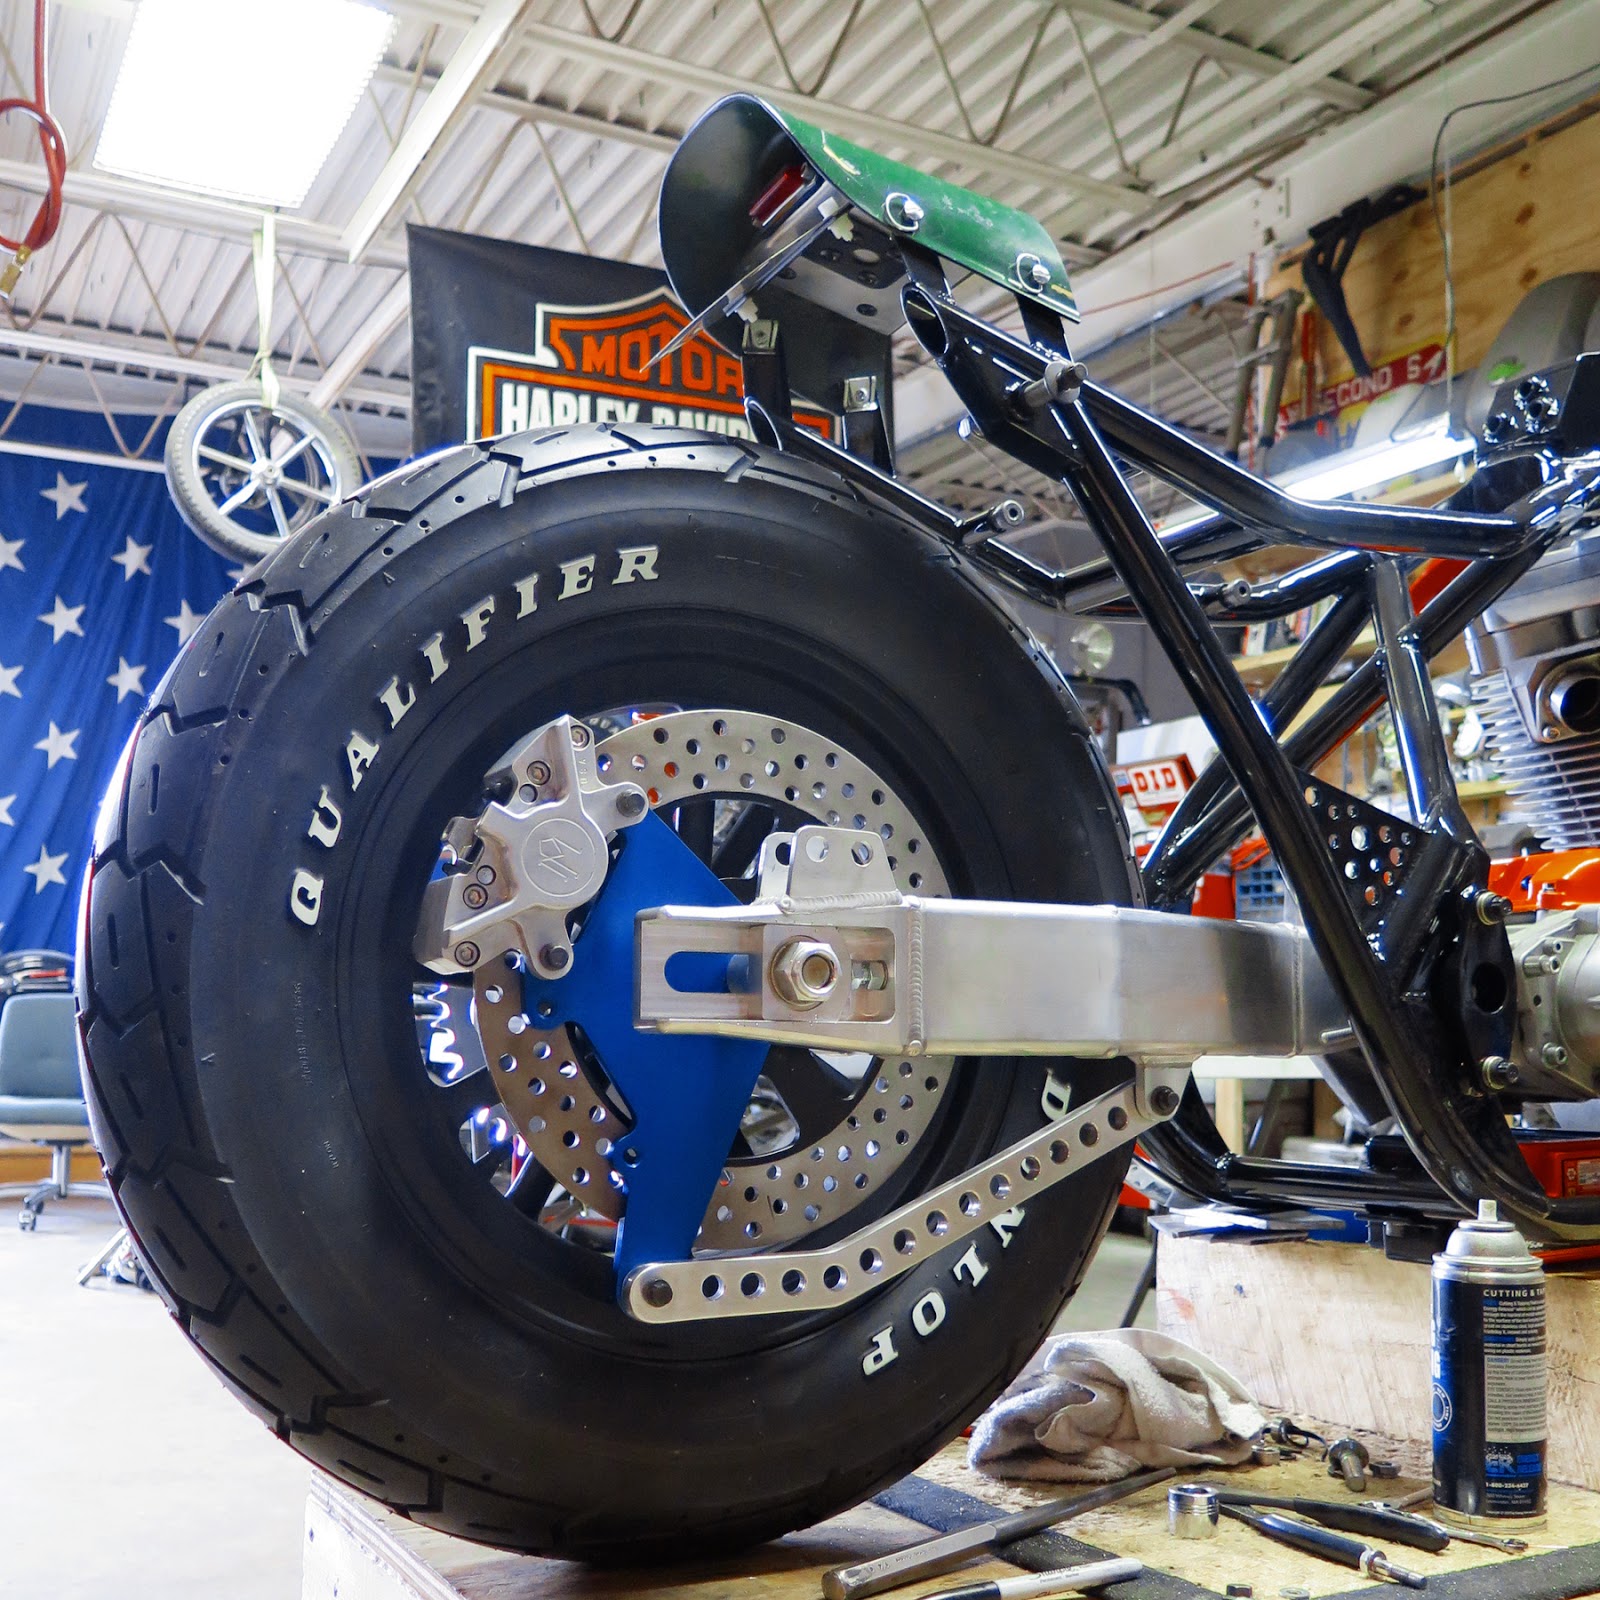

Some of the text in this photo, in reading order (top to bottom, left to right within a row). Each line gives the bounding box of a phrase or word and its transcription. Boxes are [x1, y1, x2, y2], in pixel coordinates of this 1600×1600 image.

[582, 320, 744, 397] MOTOR
[289, 545, 660, 926] QUALIFIER
[1134, 767, 1176, 792] DID
[1483, 1289, 1528, 1297] CUTTING
